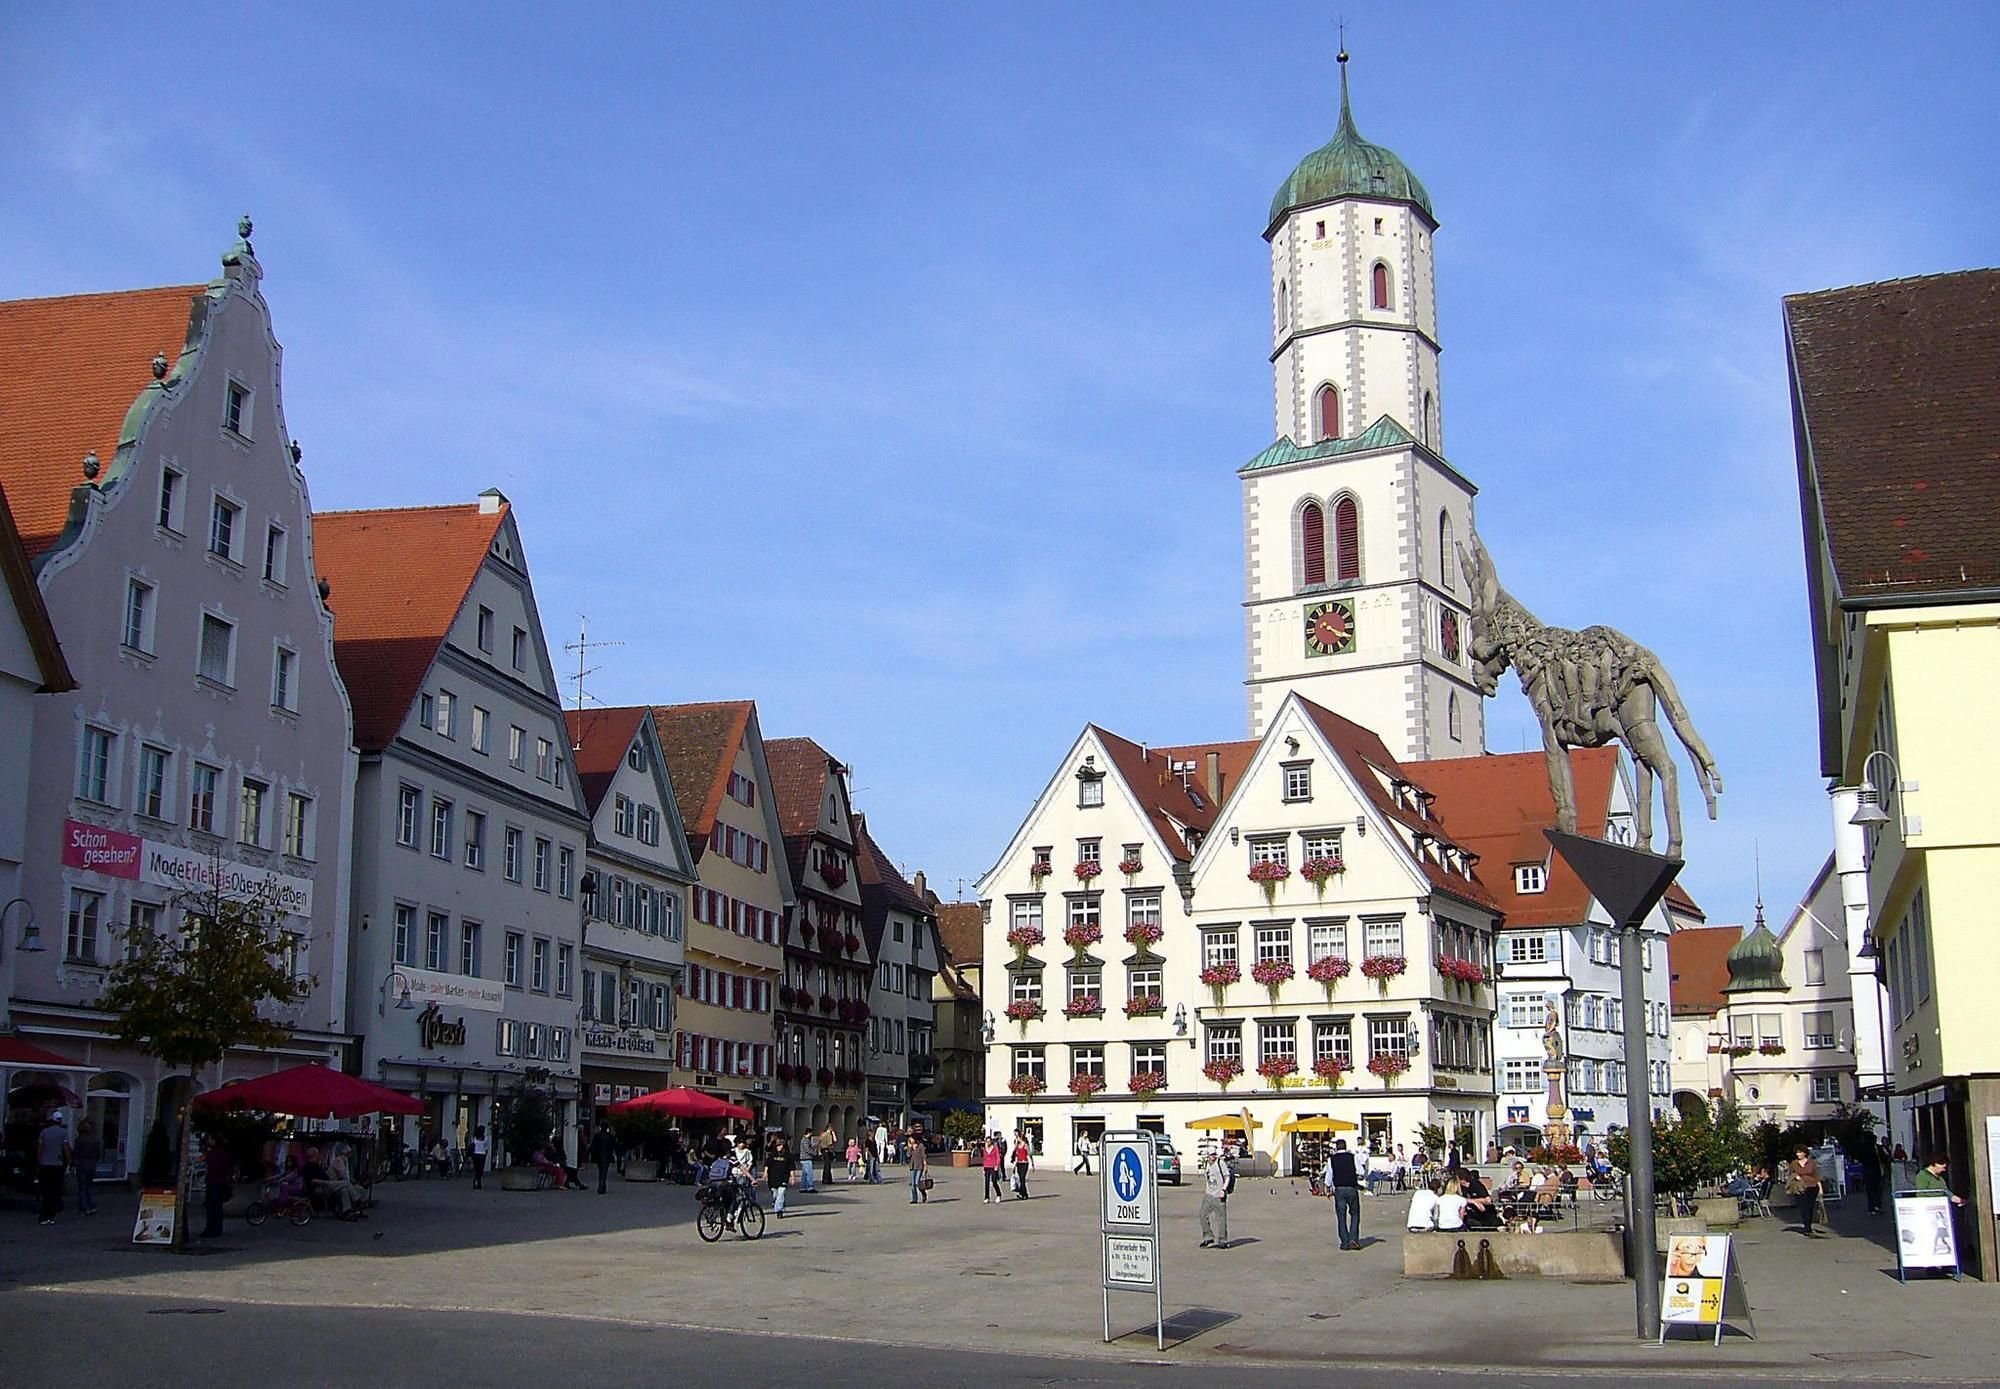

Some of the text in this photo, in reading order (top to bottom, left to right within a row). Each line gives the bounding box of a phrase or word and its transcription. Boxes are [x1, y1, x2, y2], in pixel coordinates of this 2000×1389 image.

[71, 829, 107, 848] Schon
[82, 846, 137, 868] gesehen?
[1117, 1205, 1141, 1219] ZONE
